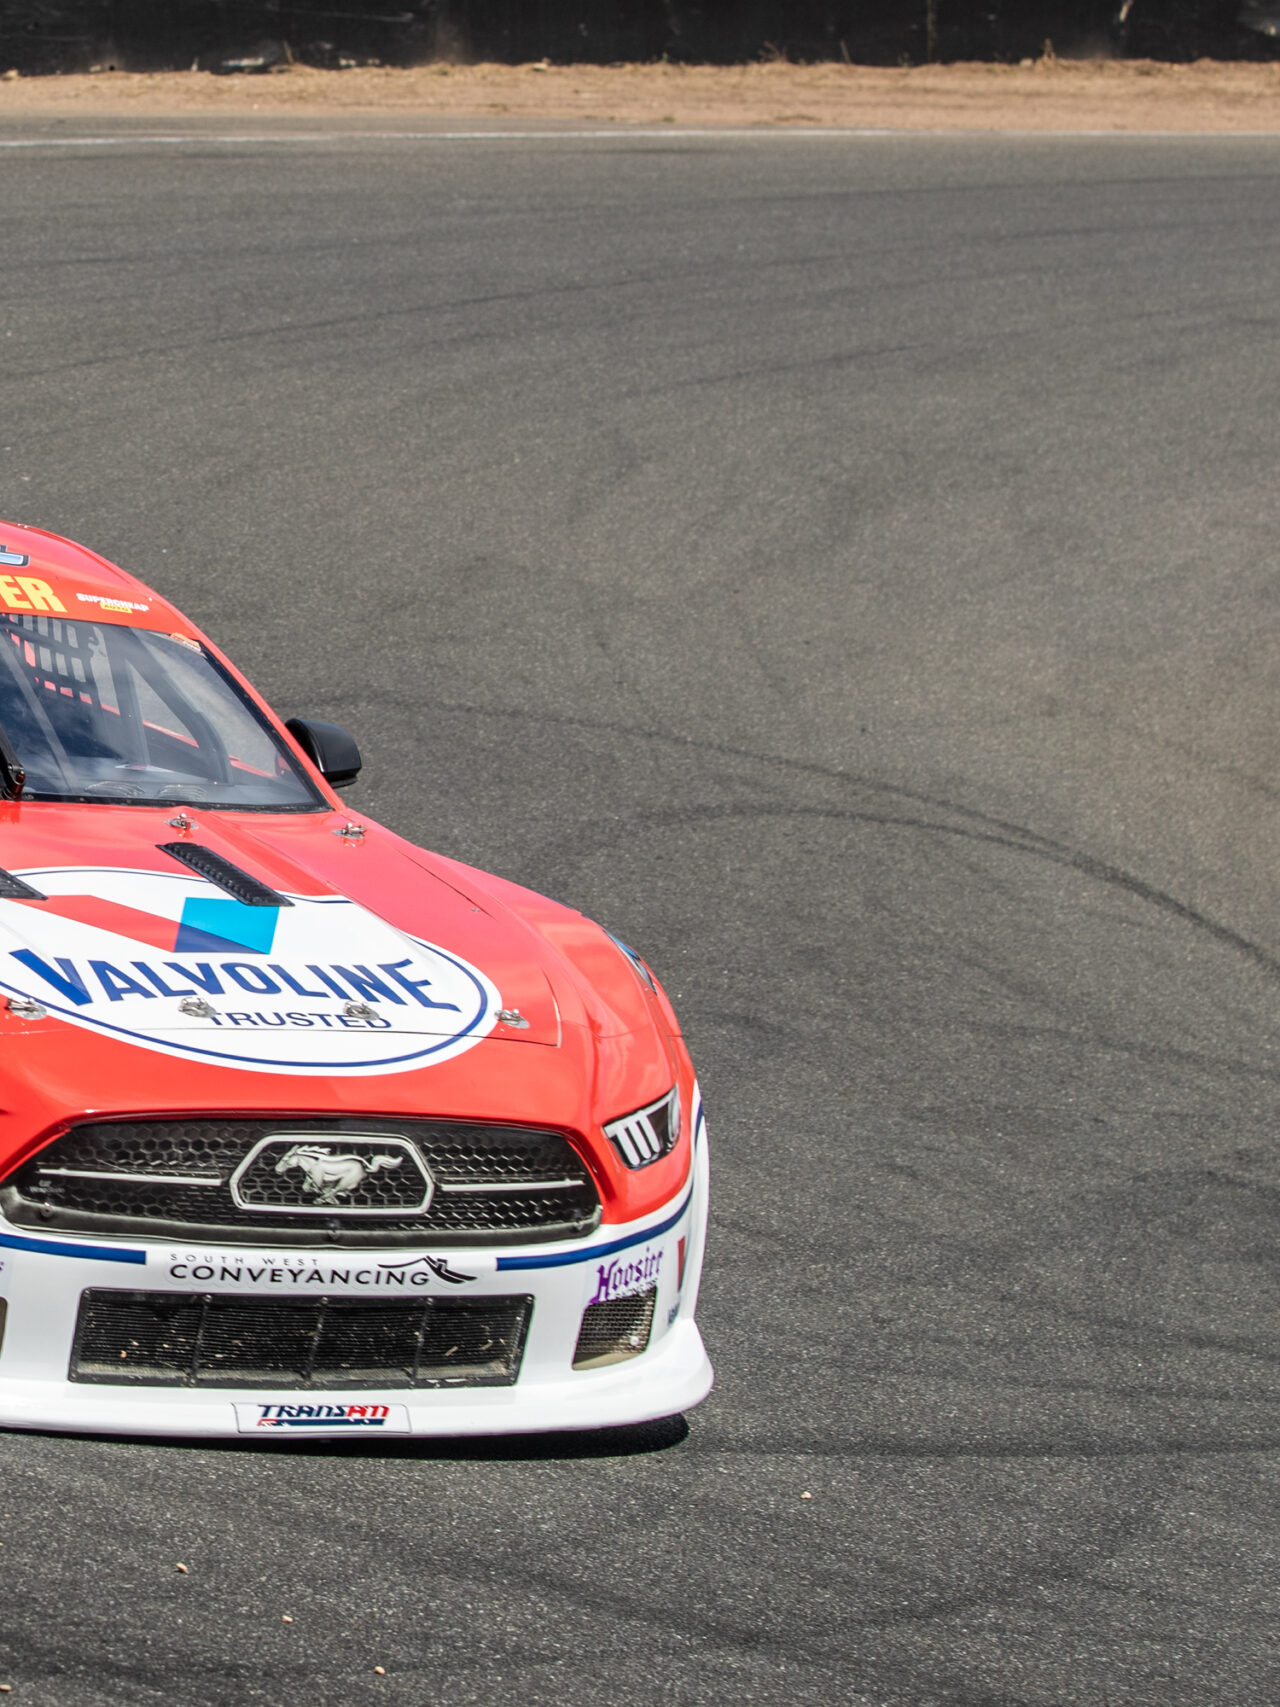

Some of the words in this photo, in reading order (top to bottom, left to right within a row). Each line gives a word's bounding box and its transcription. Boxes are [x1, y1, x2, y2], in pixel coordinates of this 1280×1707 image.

[9, 948, 461, 1012] VALVOLINE
[210, 1010, 392, 1029] TRUSTED
[169, 1253, 244, 1264] SOUTH
[262, 1256, 320, 1267] WEST
[170, 1263, 431, 1286] CONVEYANCING
